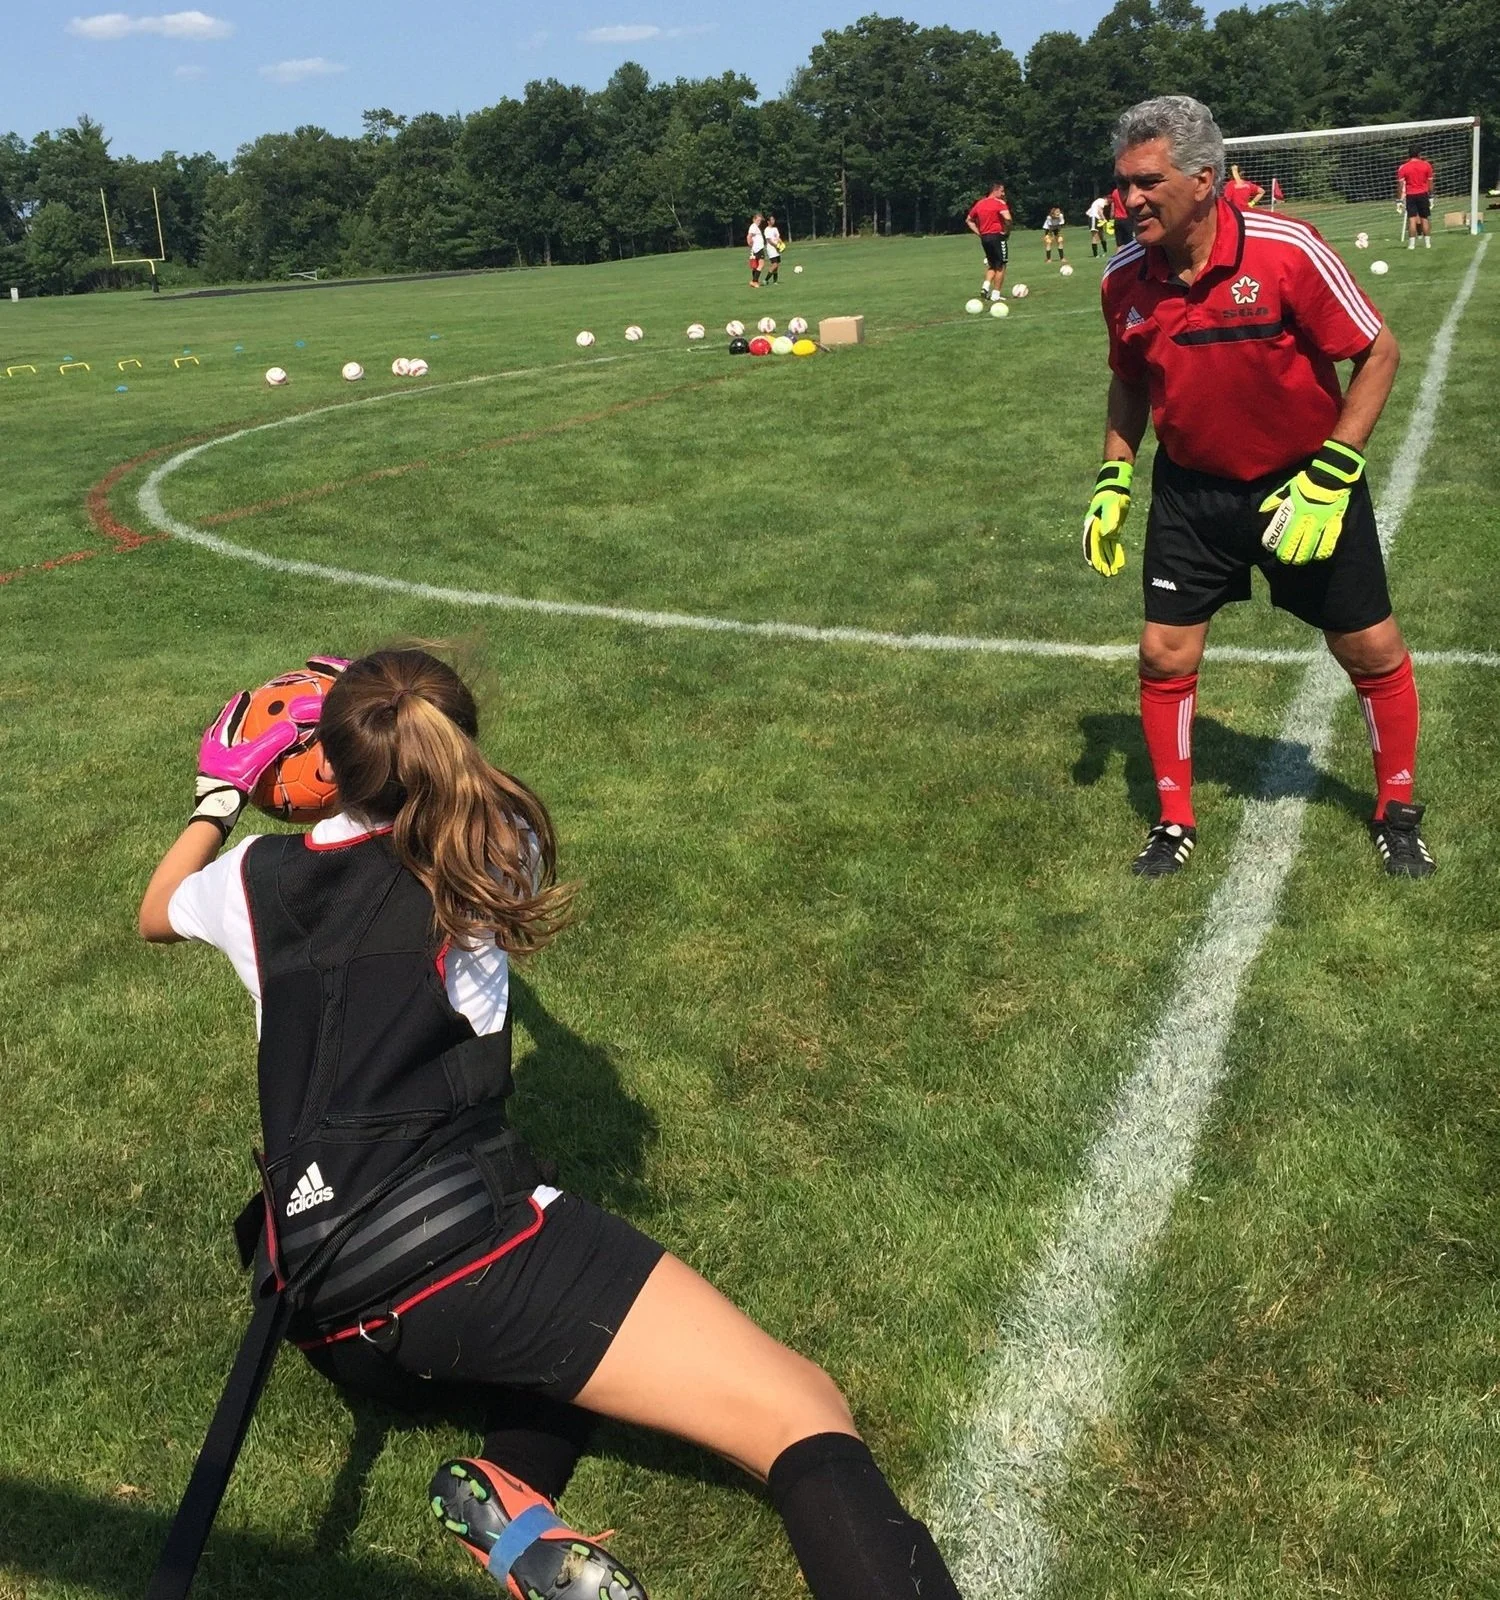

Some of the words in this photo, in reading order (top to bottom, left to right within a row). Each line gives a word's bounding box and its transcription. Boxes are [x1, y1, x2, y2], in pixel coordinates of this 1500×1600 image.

[1266, 506, 1291, 550] reusch
[1151, 577, 1177, 591] XARA
[286, 1186, 335, 1217] adidas
